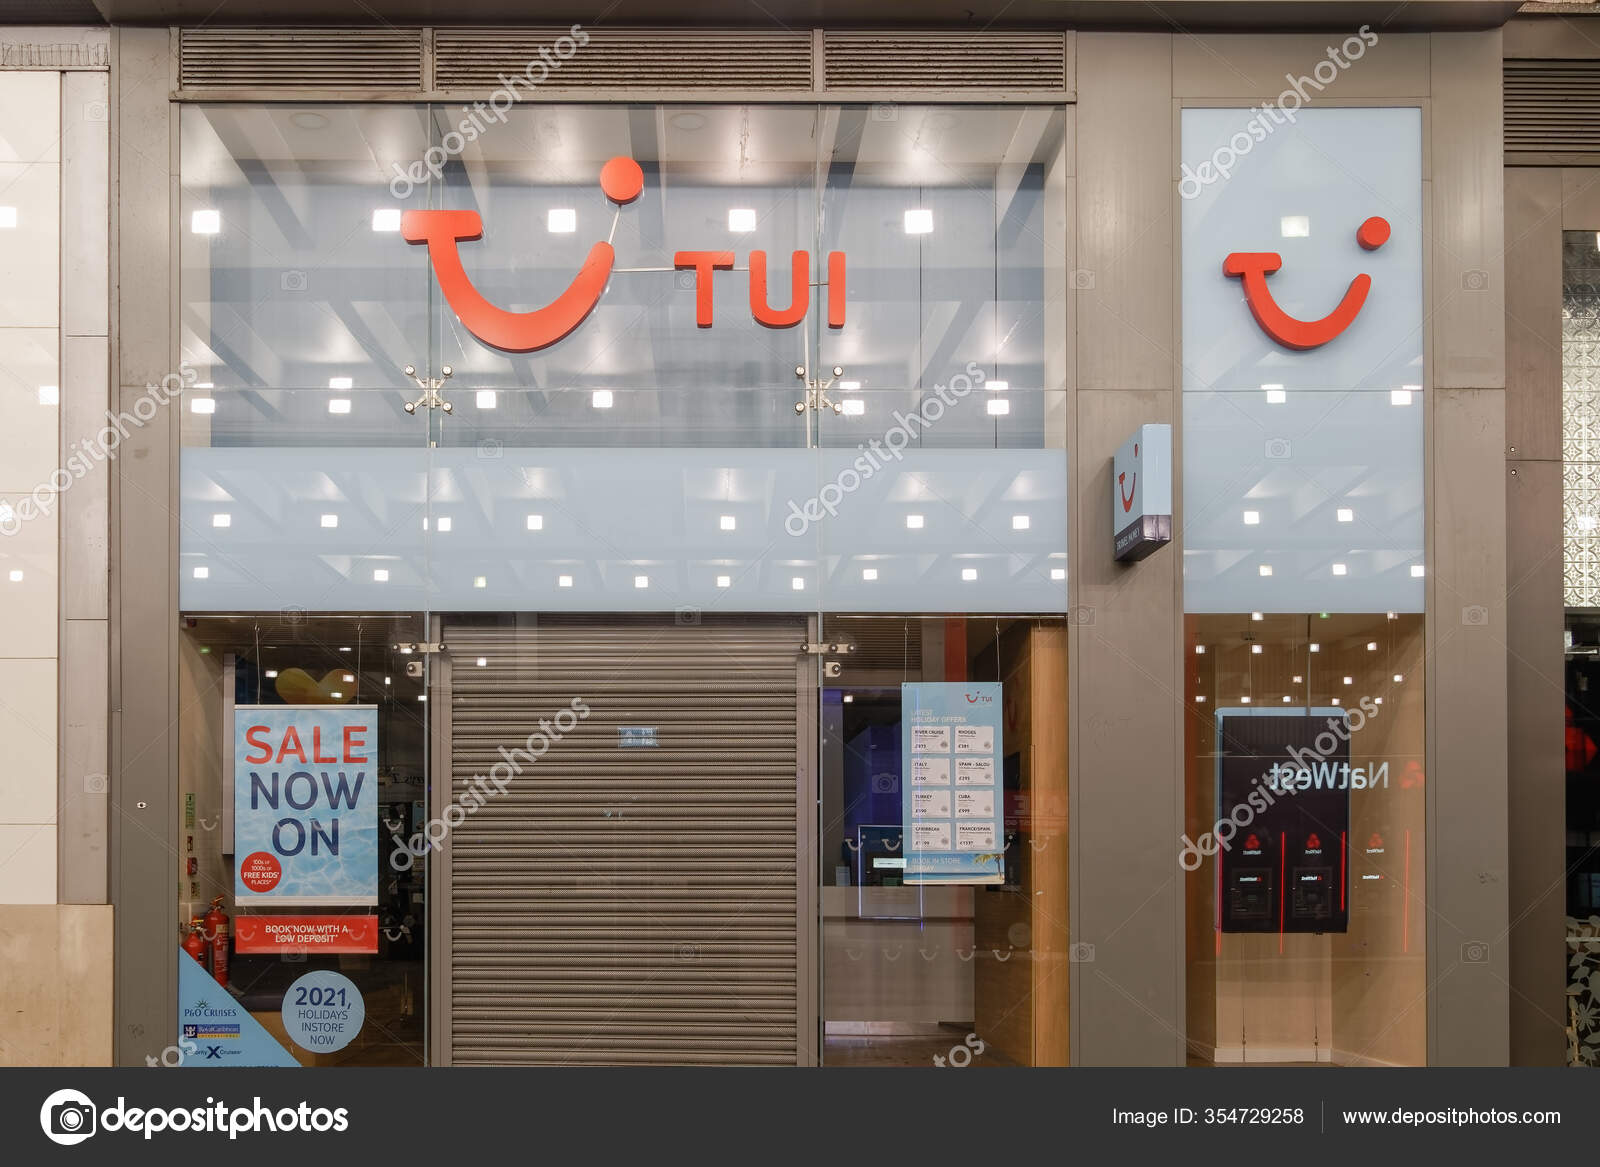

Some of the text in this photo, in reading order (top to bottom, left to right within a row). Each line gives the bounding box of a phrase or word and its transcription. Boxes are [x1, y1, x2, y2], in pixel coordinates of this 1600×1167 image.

[674, 250, 846, 329] TUI
[245, 725, 368, 765] SALE
[249, 771, 366, 811] NOW
[272, 817, 339, 857] ON
[265, 925, 349, 933] BOOK NOW WITH A
[275, 935, 295, 943] LOW
[184, 1008, 237, 1017] P&O CRUISES
[298, 1009, 349, 1021] HOLIDAYS
[301, 1022, 345, 1033] INSTORE
[310, 1034, 336, 1045] NOW
